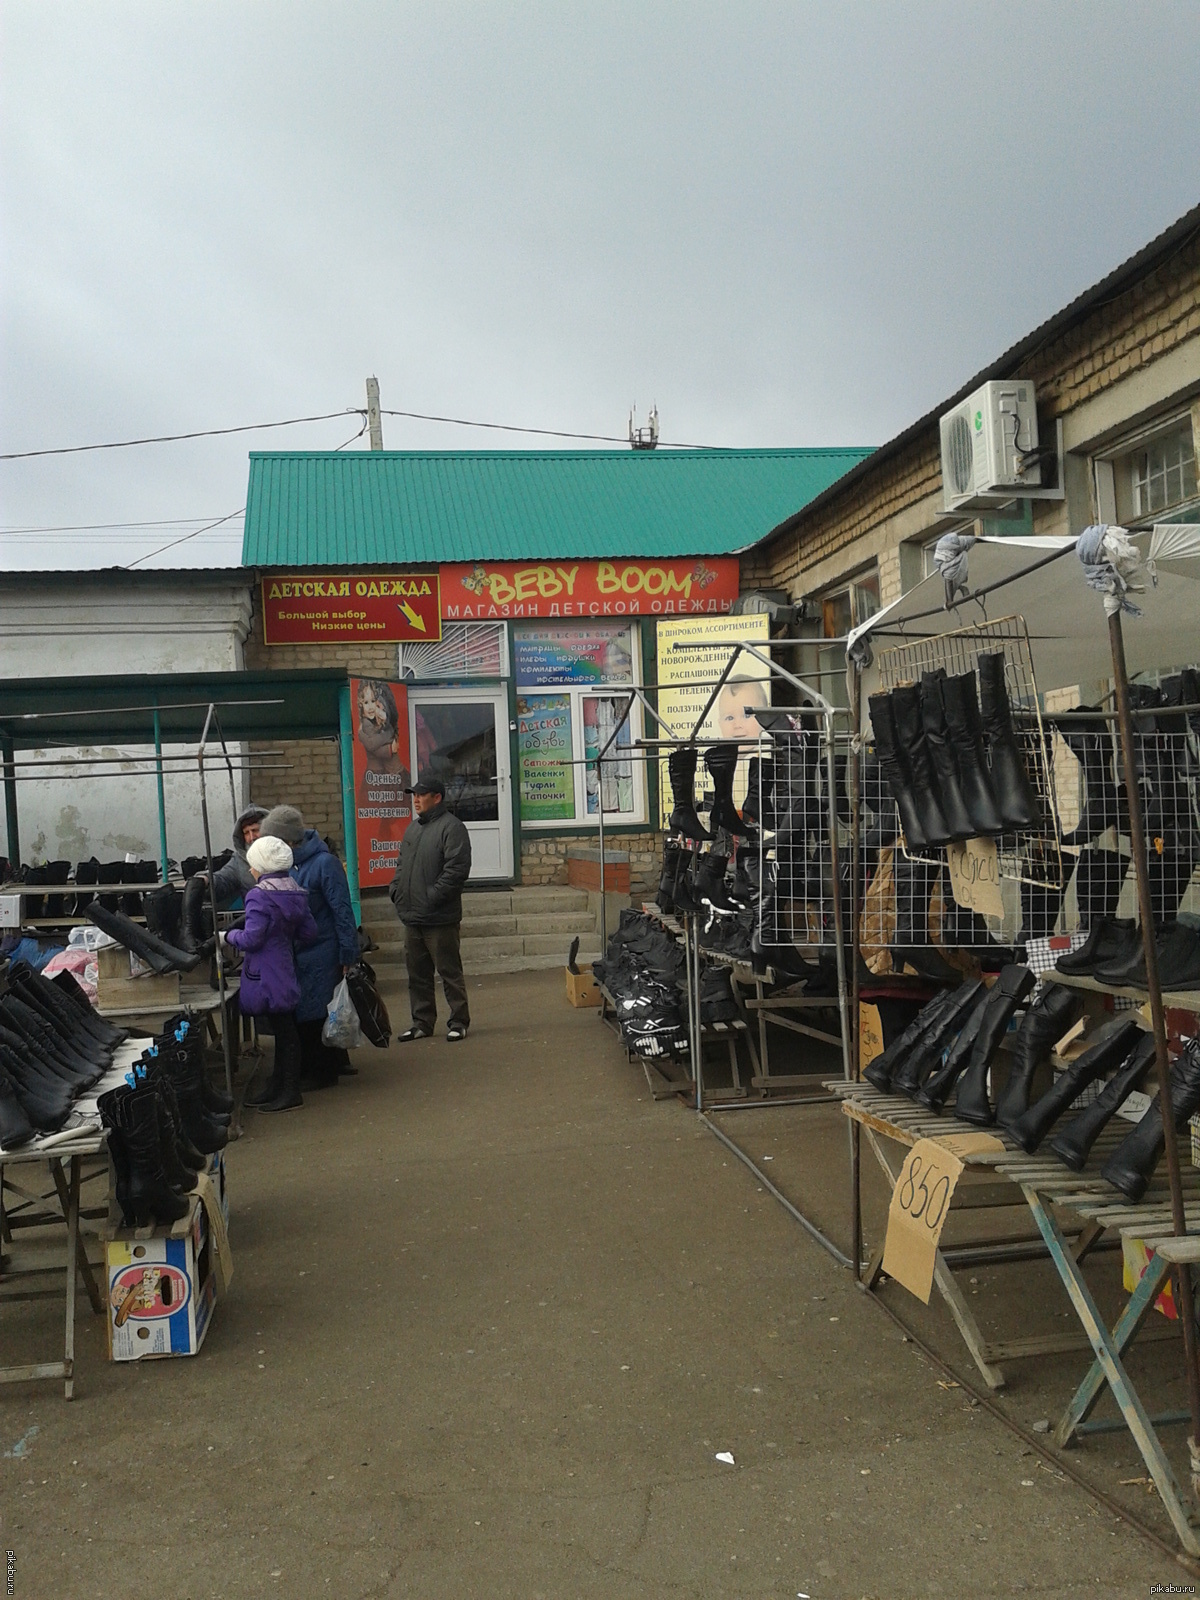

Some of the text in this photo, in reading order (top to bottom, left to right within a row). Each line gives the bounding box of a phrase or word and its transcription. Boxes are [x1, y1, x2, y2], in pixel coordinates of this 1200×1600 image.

[489, 561, 692, 604] BEBY BOOM
[269, 580, 432, 599] ДЕТСКАЯ ОДЕЖДА
[447, 598, 733, 617] МАГАЗИН ДЕТСКОЙ ОДЕЖДЫ
[278, 610, 367, 620] Большой выбор
[312, 621, 386, 631] Низкие цены
[665, 627, 703, 637] ШИРОКОМ
[661, 652, 739, 665] НОВОРОЖДЕННЫ
[670, 667, 725, 679] РАСПАШОНКИ
[519, 716, 568, 734] Детская
[525, 731, 565, 755] обувь
[366, 770, 402, 786] Оденьте
[523, 769, 565, 778] Валенки
[525, 780, 556, 790] Туфли
[368, 791, 404, 803] модно и
[525, 792, 566, 800] Тапочки
[358, 807, 411, 819] качественно
[900, 1156, 950, 1229] 850
